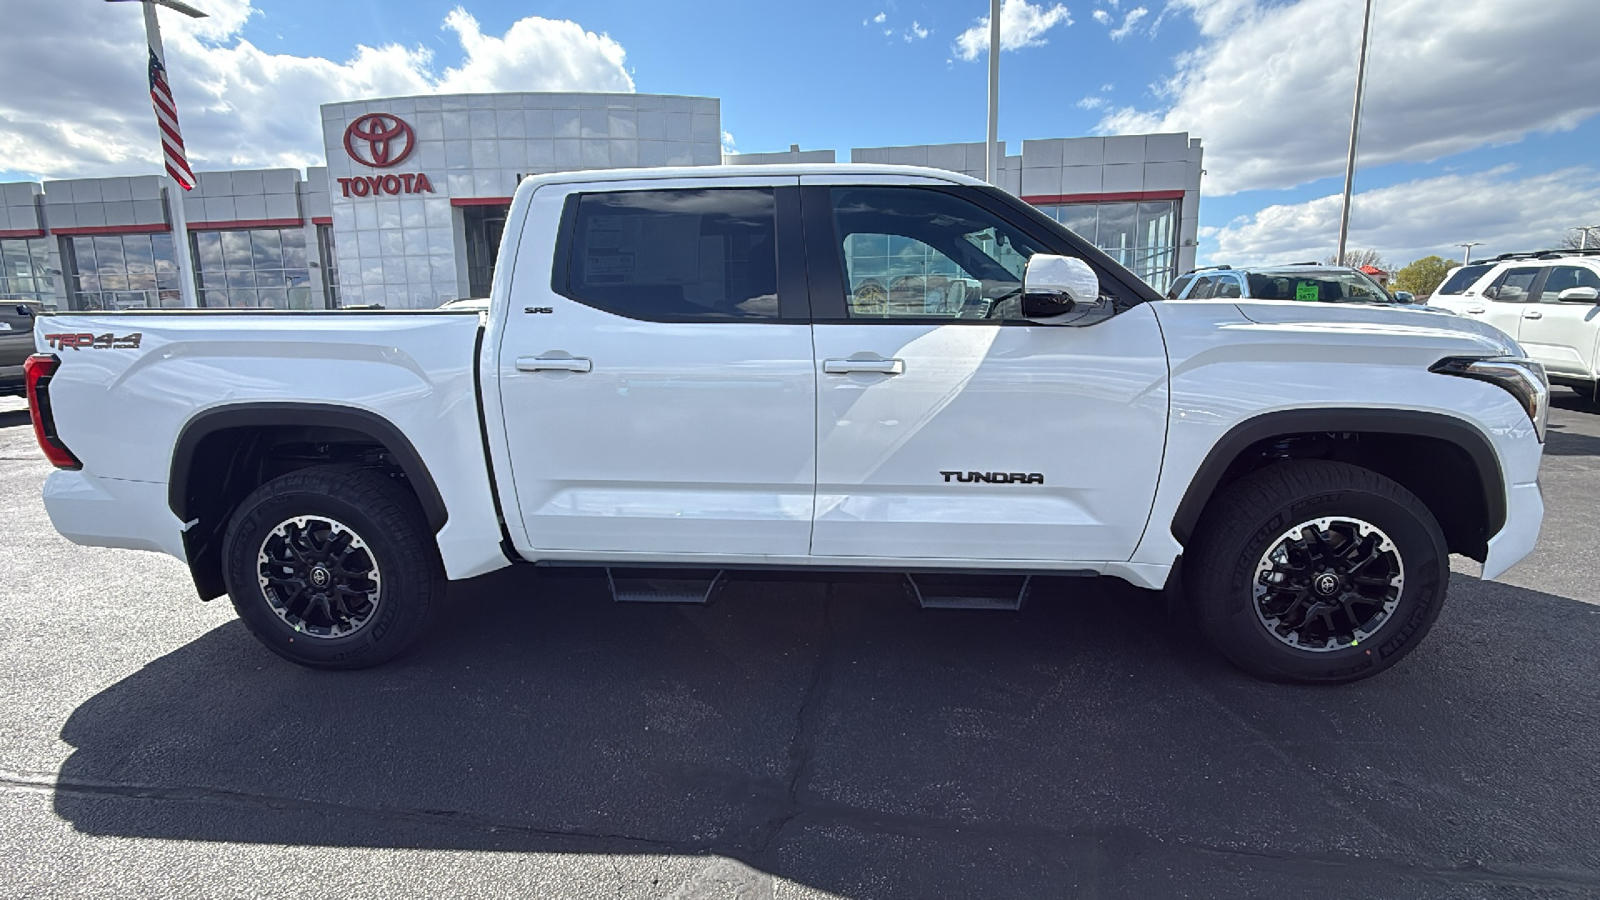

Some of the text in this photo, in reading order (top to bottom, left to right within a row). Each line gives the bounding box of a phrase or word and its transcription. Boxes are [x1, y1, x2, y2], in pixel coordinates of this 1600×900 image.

[337, 173, 433, 198] TOYOTA
[45, 333, 94, 351] TRD
[940, 471, 1044, 484] TUNDRA
